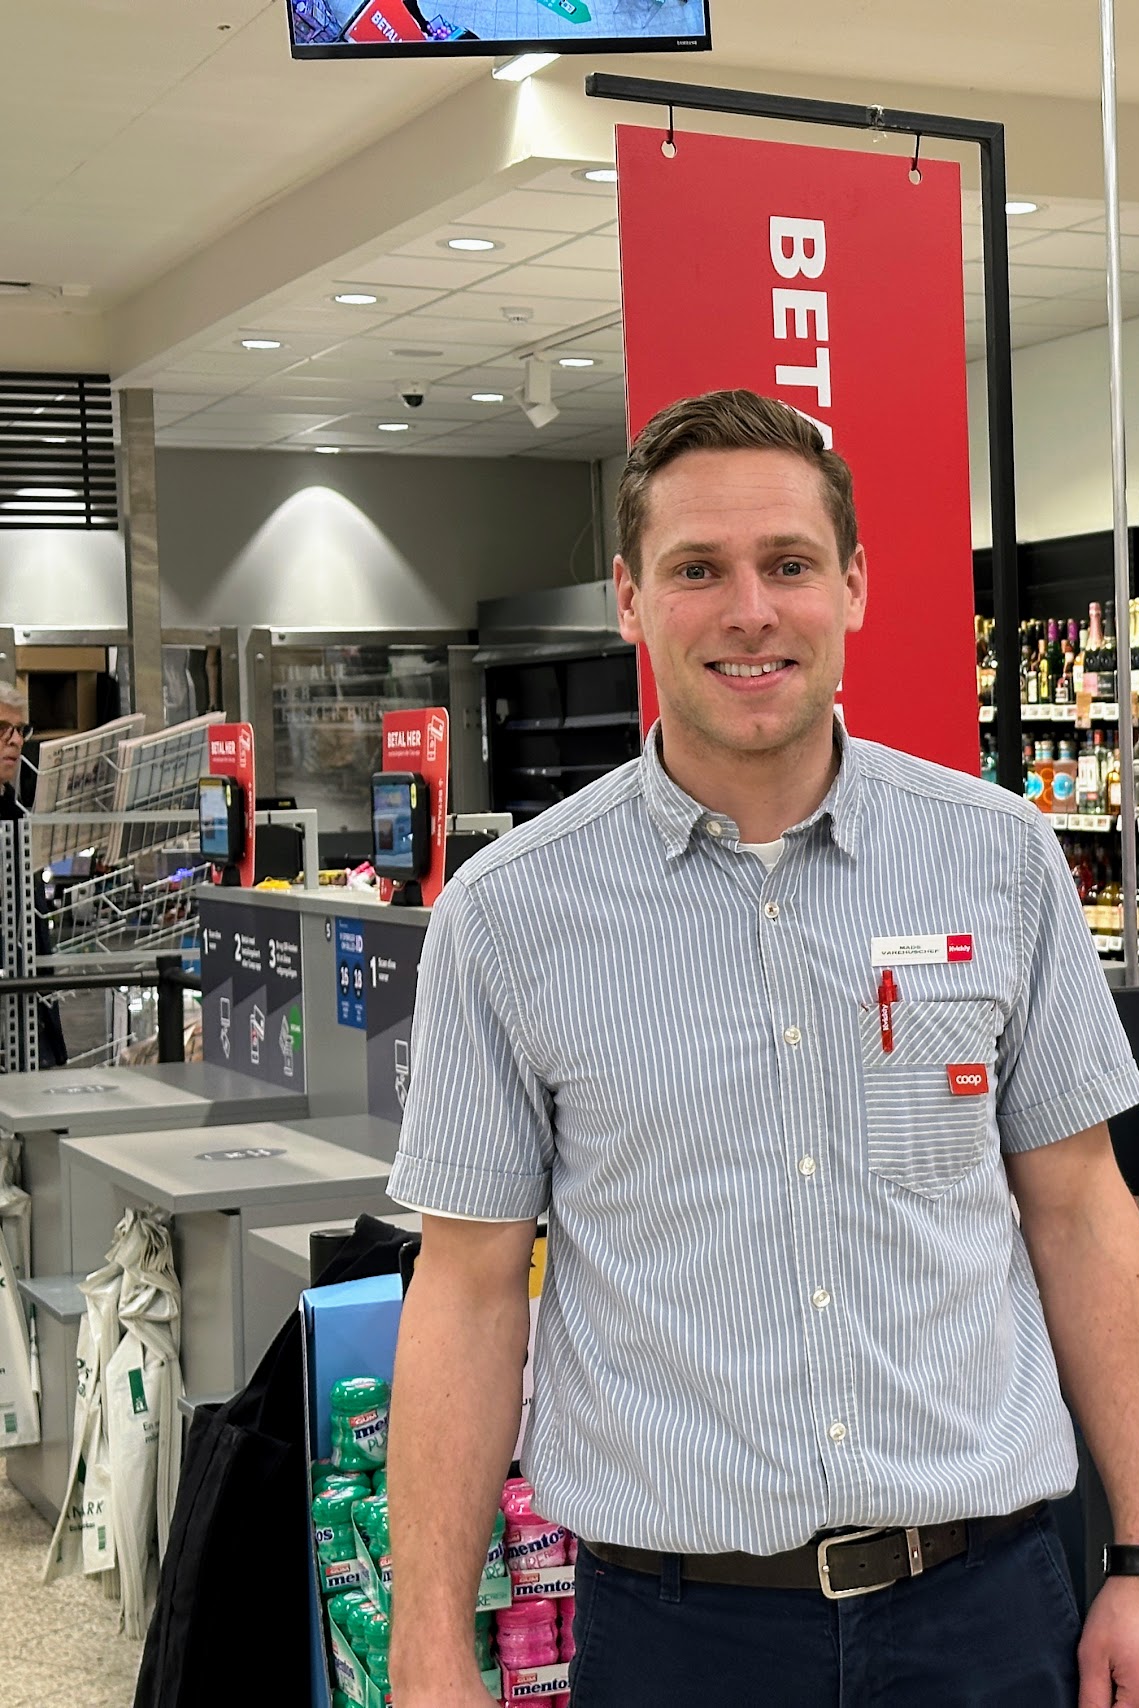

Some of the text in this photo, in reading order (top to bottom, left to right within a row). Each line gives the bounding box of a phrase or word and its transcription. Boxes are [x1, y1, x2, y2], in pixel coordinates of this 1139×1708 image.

[234, 932, 242, 962] 2
[268, 938, 276, 969] 3
[370, 956, 377, 988] 1
[956, 1074, 982, 1086] coop
[513, 1678, 570, 1697] mento
